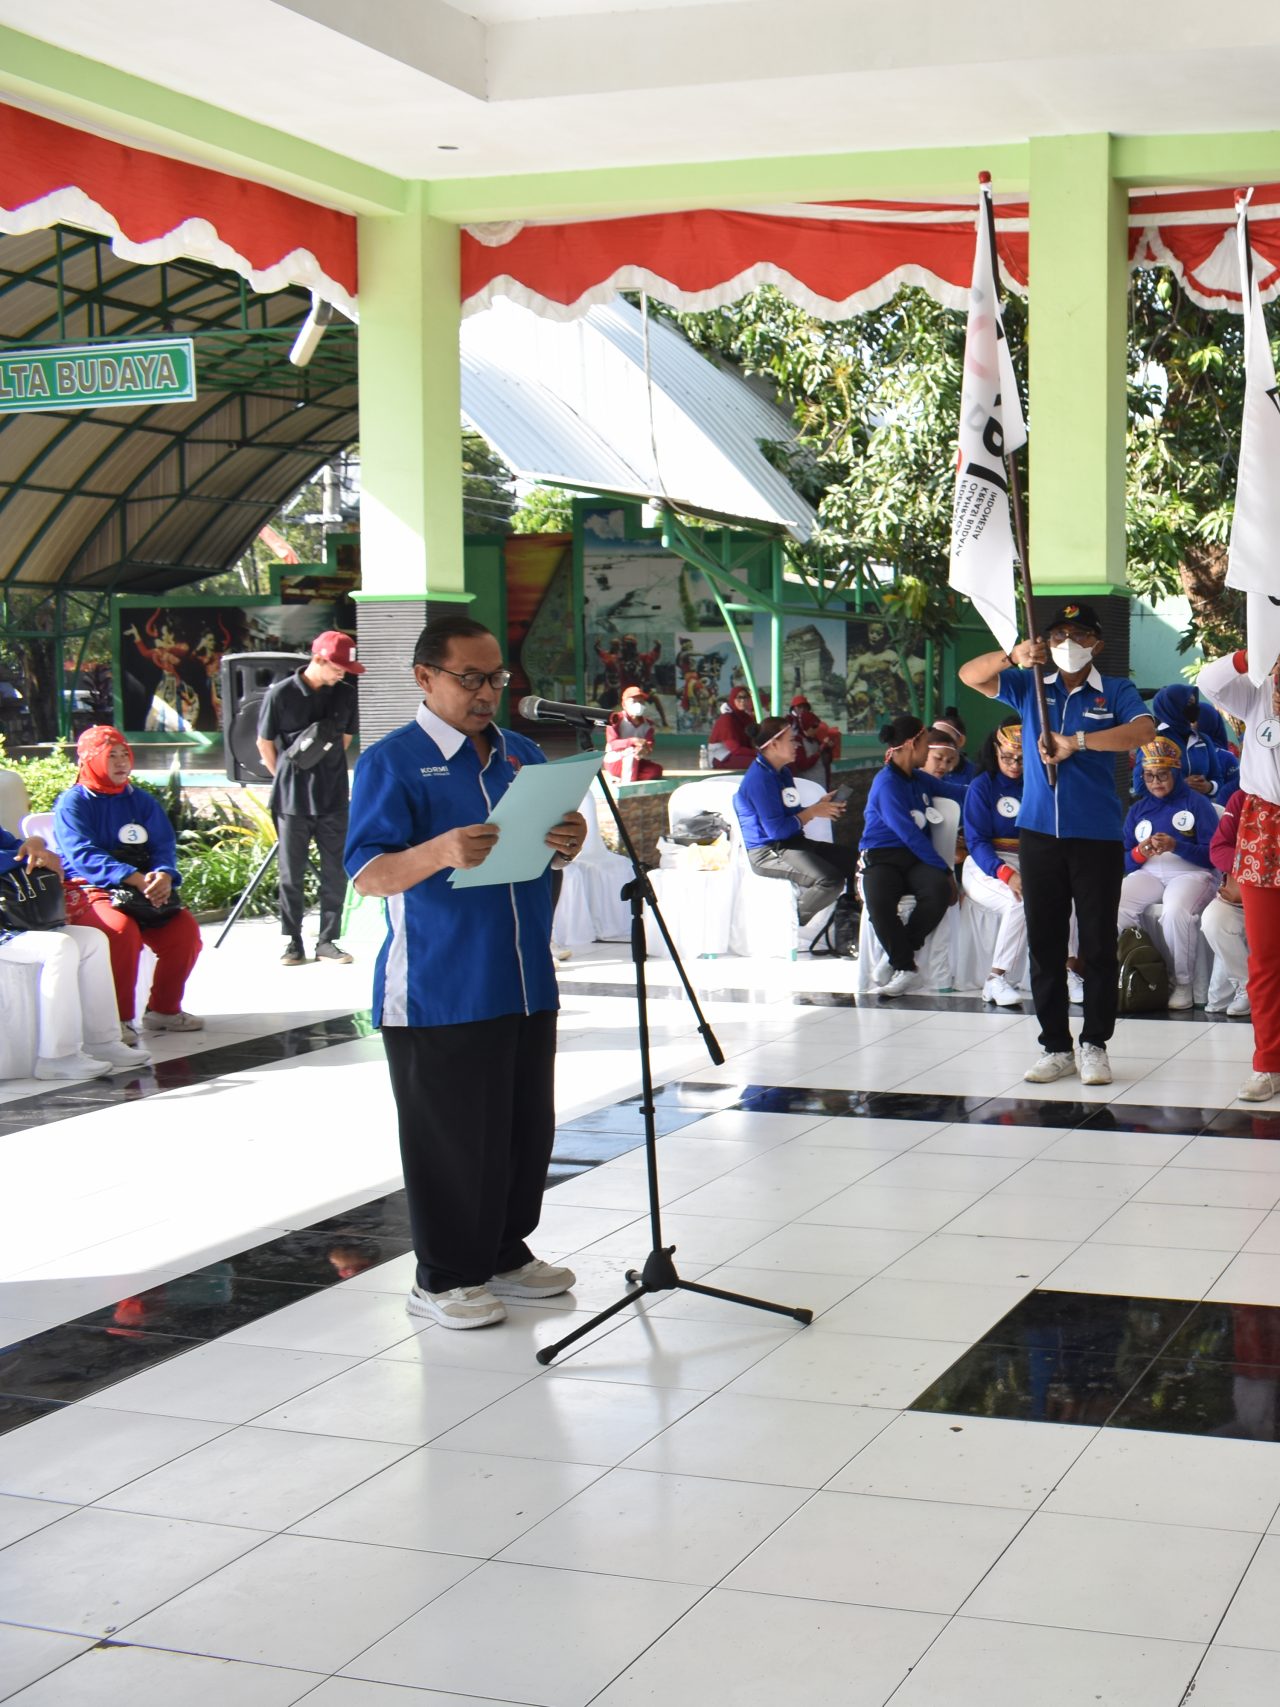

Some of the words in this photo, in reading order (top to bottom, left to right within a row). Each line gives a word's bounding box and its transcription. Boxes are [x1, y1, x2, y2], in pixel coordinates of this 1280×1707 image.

[56, 354, 179, 396] BUDAYA
[1261, 727, 1272, 742] 4
[420, 765, 449, 774] KORMI
[1003, 801, 1014, 813] 3
[128, 829, 138, 842] 3
